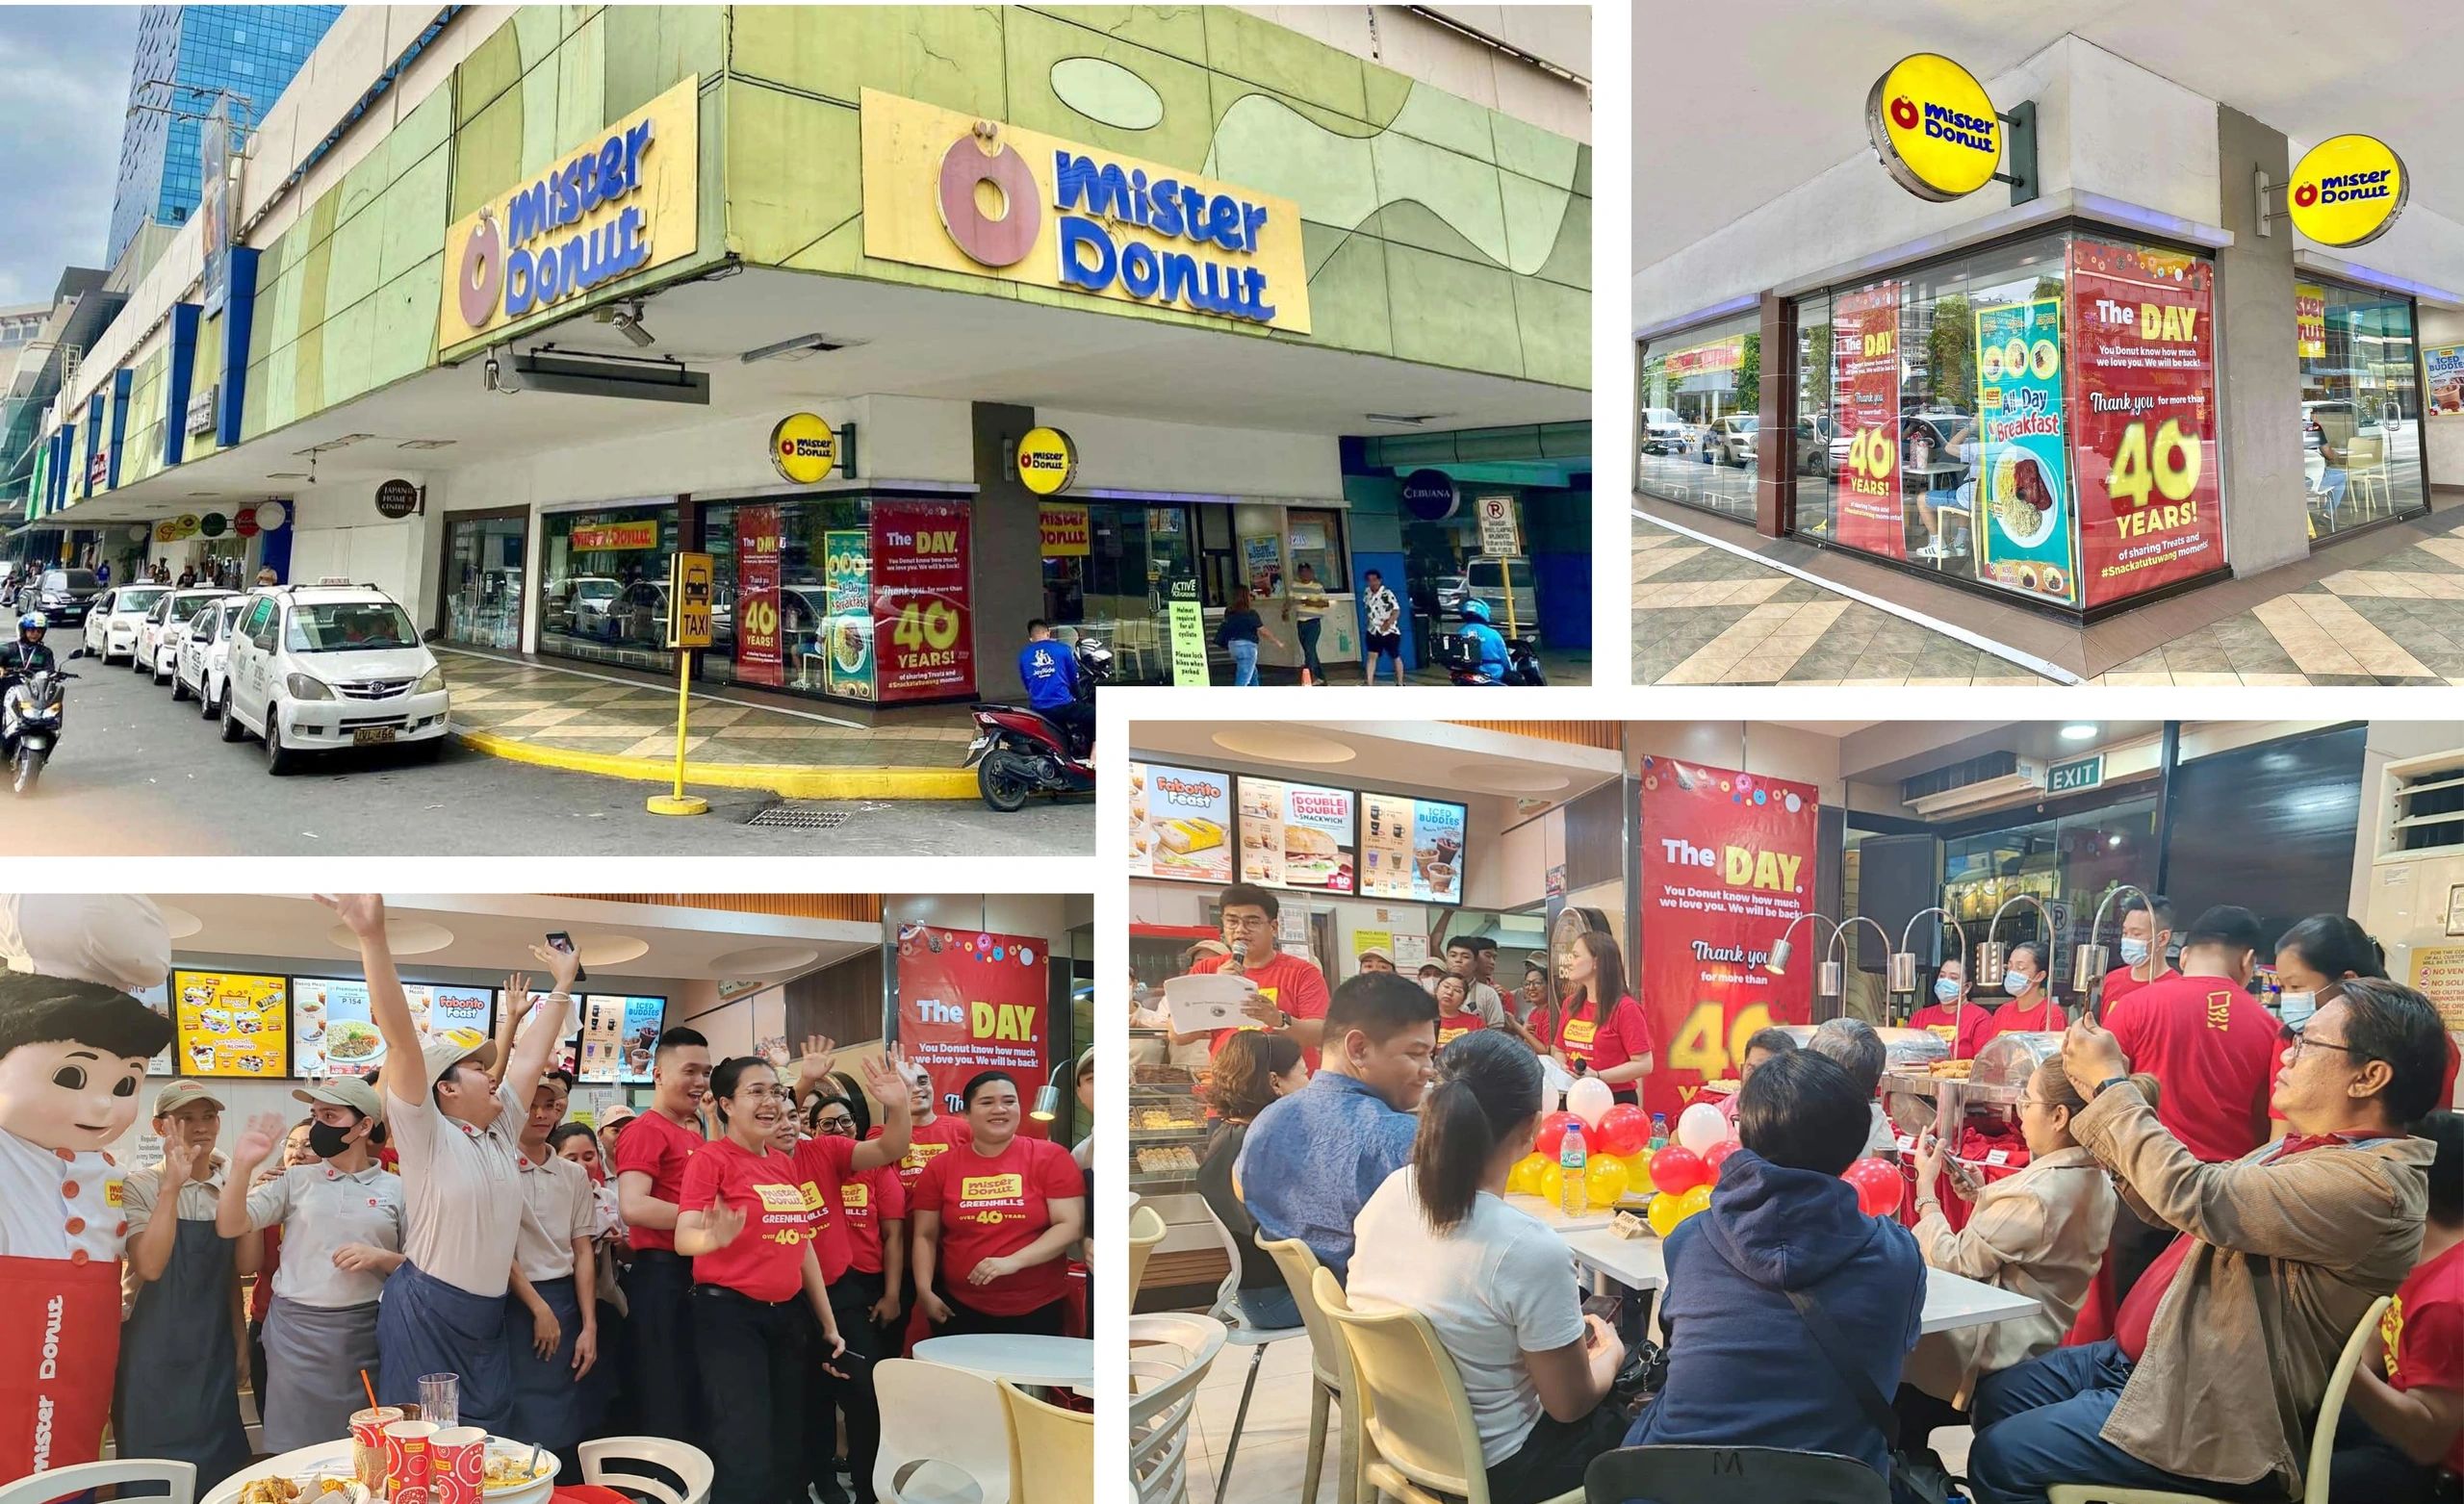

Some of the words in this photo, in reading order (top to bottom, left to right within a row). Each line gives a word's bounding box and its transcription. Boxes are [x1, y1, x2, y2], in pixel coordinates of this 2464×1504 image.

[1924, 102, 1994, 135] Mister
[1925, 118, 1995, 153] Donut
[508, 117, 654, 248] Mister
[2322, 169, 2392, 190] Mister
[1052, 150, 1267, 254] Mister
[2322, 185, 2390, 204] Donut
[505, 206, 652, 316] Donut
[1056, 216, 1275, 322] Donut
[2296, 296, 2324, 318] ster
[2095, 300, 2134, 324] The
[2141, 303, 2198, 342] DAY.
[2297, 322, 2325, 342] nut
[1845, 338, 1861, 351] The
[2098, 345, 2116, 354] You
[2116, 346, 2140, 355] Donut
[2140, 346, 2162, 356] know
[2162, 347, 2177, 356] how
[2178, 348, 2196, 357] much
[2110, 358, 2126, 368] love
[2127, 359, 2144, 369] you.
[2144, 358, 2158, 368] We
[2158, 358, 2171, 368] will
[2172, 358, 2183, 368] be
[2429, 362, 2464, 371] BUDDIE
[2021, 388, 2047, 412] Day
[2090, 392, 2132, 414] Thank
[2134, 397, 2155, 416] you
[2158, 395, 2169, 404] for
[2187, 395, 2205, 404] than
[1997, 411, 2059, 443] Breakfast
[797, 439, 832, 448] Mister
[797, 446, 833, 458] Donut
[1848, 427, 1896, 479] 40
[1033, 451, 1064, 461] Mister
[1033, 460, 1064, 470] Donut
[2109, 418, 2202, 508] 40
[1403, 487, 1451, 499] CEBUANA
[1851, 477, 1889, 497] YEARS!
[2116, 500, 2197, 540] YEARS!
[743, 537, 755, 547] The
[886, 531, 912, 547] The
[916, 531, 959, 554] DAY.
[2118, 552, 2128, 561] of
[2129, 544, 2161, 559] sharing
[2162, 538, 2185, 551] Treats
[2186, 532, 2200, 543] and
[2101, 550, 2178, 578] #Snackatutuwang
[1171, 579, 1196, 594] ACTIVE
[683, 614, 708, 636] TAXI
[745, 600, 778, 636] 40
[893, 600, 960, 652] 40
[747, 635, 774, 648] YEARS!
[898, 650, 956, 670] YEARS!
[2053, 765, 2093, 790] EXIT
[1157, 777, 1220, 799] Faborito
[1168, 791, 1211, 808] Feast
[1296, 796, 1344, 806] DOUBLE
[1297, 806, 1344, 816] DOUBLE
[1299, 814, 1343, 824] SNACKWICH
[1419, 814, 1460, 826] BUDDIES
[1428, 808, 1451, 817] ICED
[1662, 838, 1716, 868] The
[1725, 845, 1804, 895] DAY.
[1664, 885, 1685, 896] You
[1687, 887, 1722, 900] Donut
[1723, 890, 1751, 903] know
[1752, 895, 1773, 906] how
[1774, 898, 1800, 909] much
[1659, 899, 1677, 908] we
[1679, 898, 1703, 909] love
[1704, 903, 1727, 913] you.
[1729, 903, 1744, 914] We
[1746, 905, 1764, 917] will
[1765, 908, 1777, 918] be
[1692, 940, 1745, 964] Thank
[1701, 972, 1717, 981] for
[1719, 974, 1744, 984] more
[1745, 975, 1767, 985] than
[439, 995, 485, 1010] Faborito
[447, 1008, 477, 1019] Feast
[916, 999, 963, 1023] The
[971, 1001, 1039, 1042] DAY.
[918, 1043, 938, 1053] You
[939, 1043, 970, 1054] Donut
[970, 1045, 995, 1055] know
[995, 1046, 1013, 1056] how
[915, 1056, 931, 1064] we
[932, 1055, 954, 1064] love
[955, 1057, 975, 1066] you.
[976, 1057, 989, 1066] We
[989, 1058, 1006, 1067] will
[1007, 1058, 1016, 1067] be
[968, 1178, 1015, 1189] Mister
[968, 1185, 1015, 1195] Donut
[760, 1189, 797, 1199] Mister
[767, 1197, 803, 1206] Donut
[959, 1199, 1024, 1209] GREENHILLS
[762, 1214, 808, 1224] GREENHILL
[976, 1211, 1003, 1224] 40
[774, 1229, 800, 1245] 40
[38, 1294, 64, 1380] Donut
